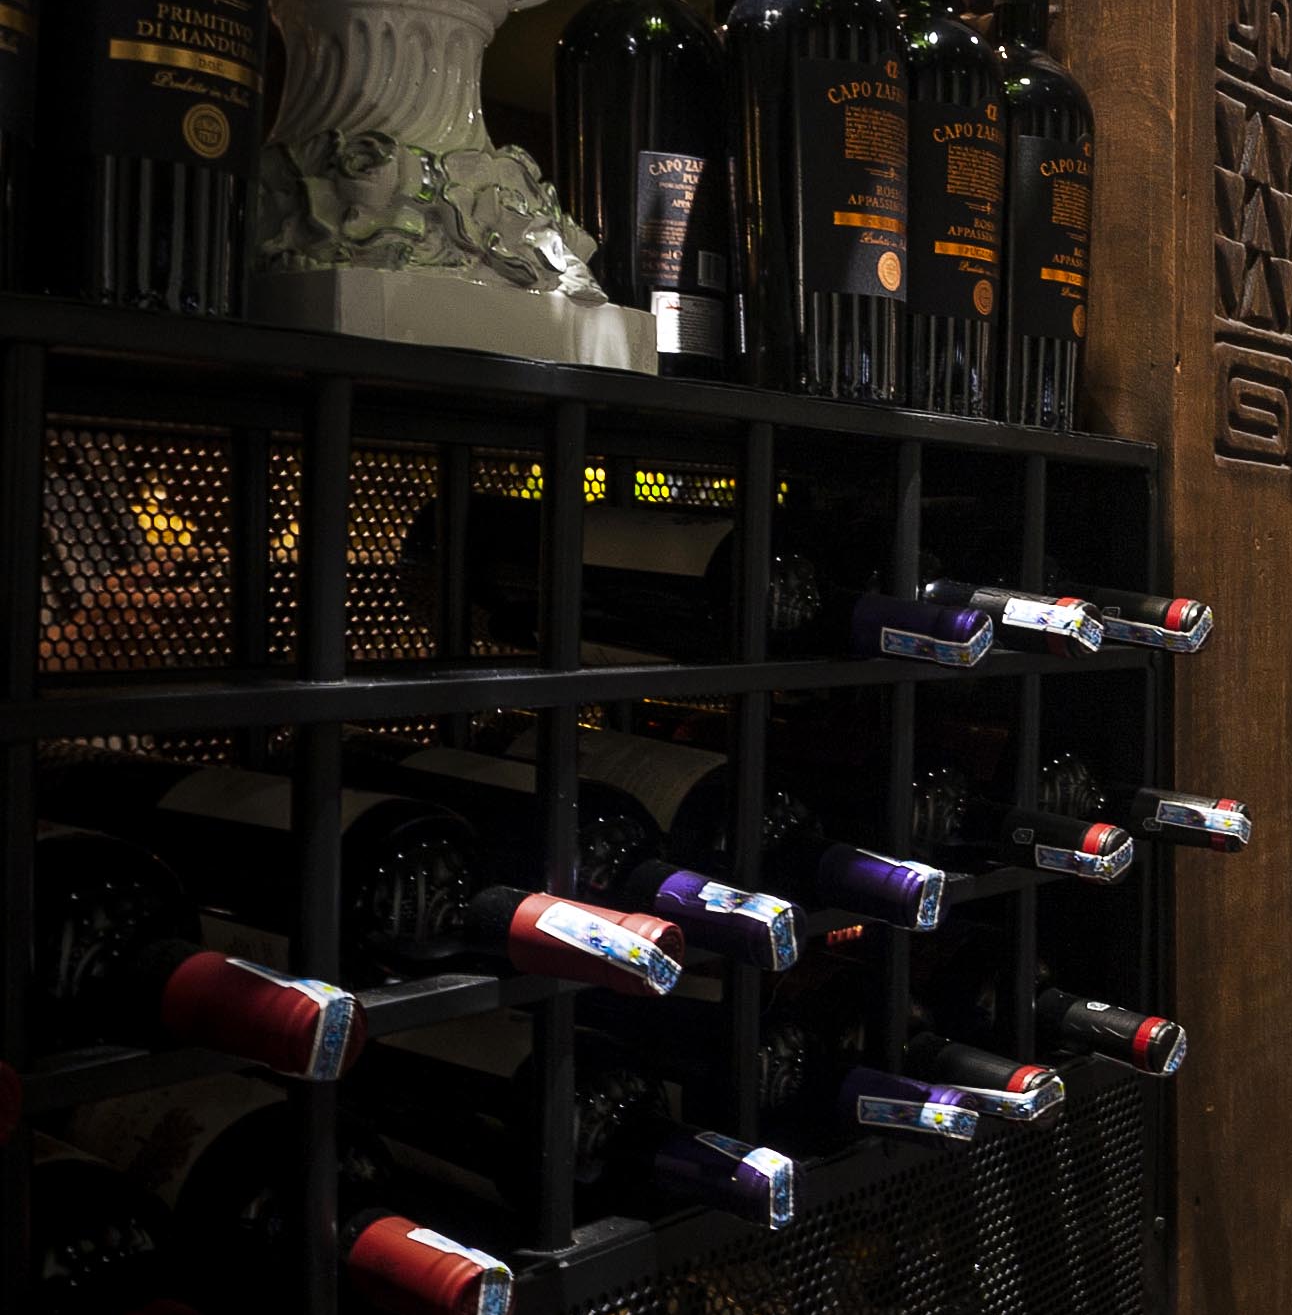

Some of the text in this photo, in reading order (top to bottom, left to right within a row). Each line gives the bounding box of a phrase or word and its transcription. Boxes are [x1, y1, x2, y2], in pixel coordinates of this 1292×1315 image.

[136, 19, 163, 38] DI
[156, 3, 254, 40] PRIMITIVO
[827, 81, 870, 104] CAPO
[932, 122, 973, 143] CAPO
[649, 159, 682, 176] CAPO
[1040, 159, 1074, 177] CAPO
